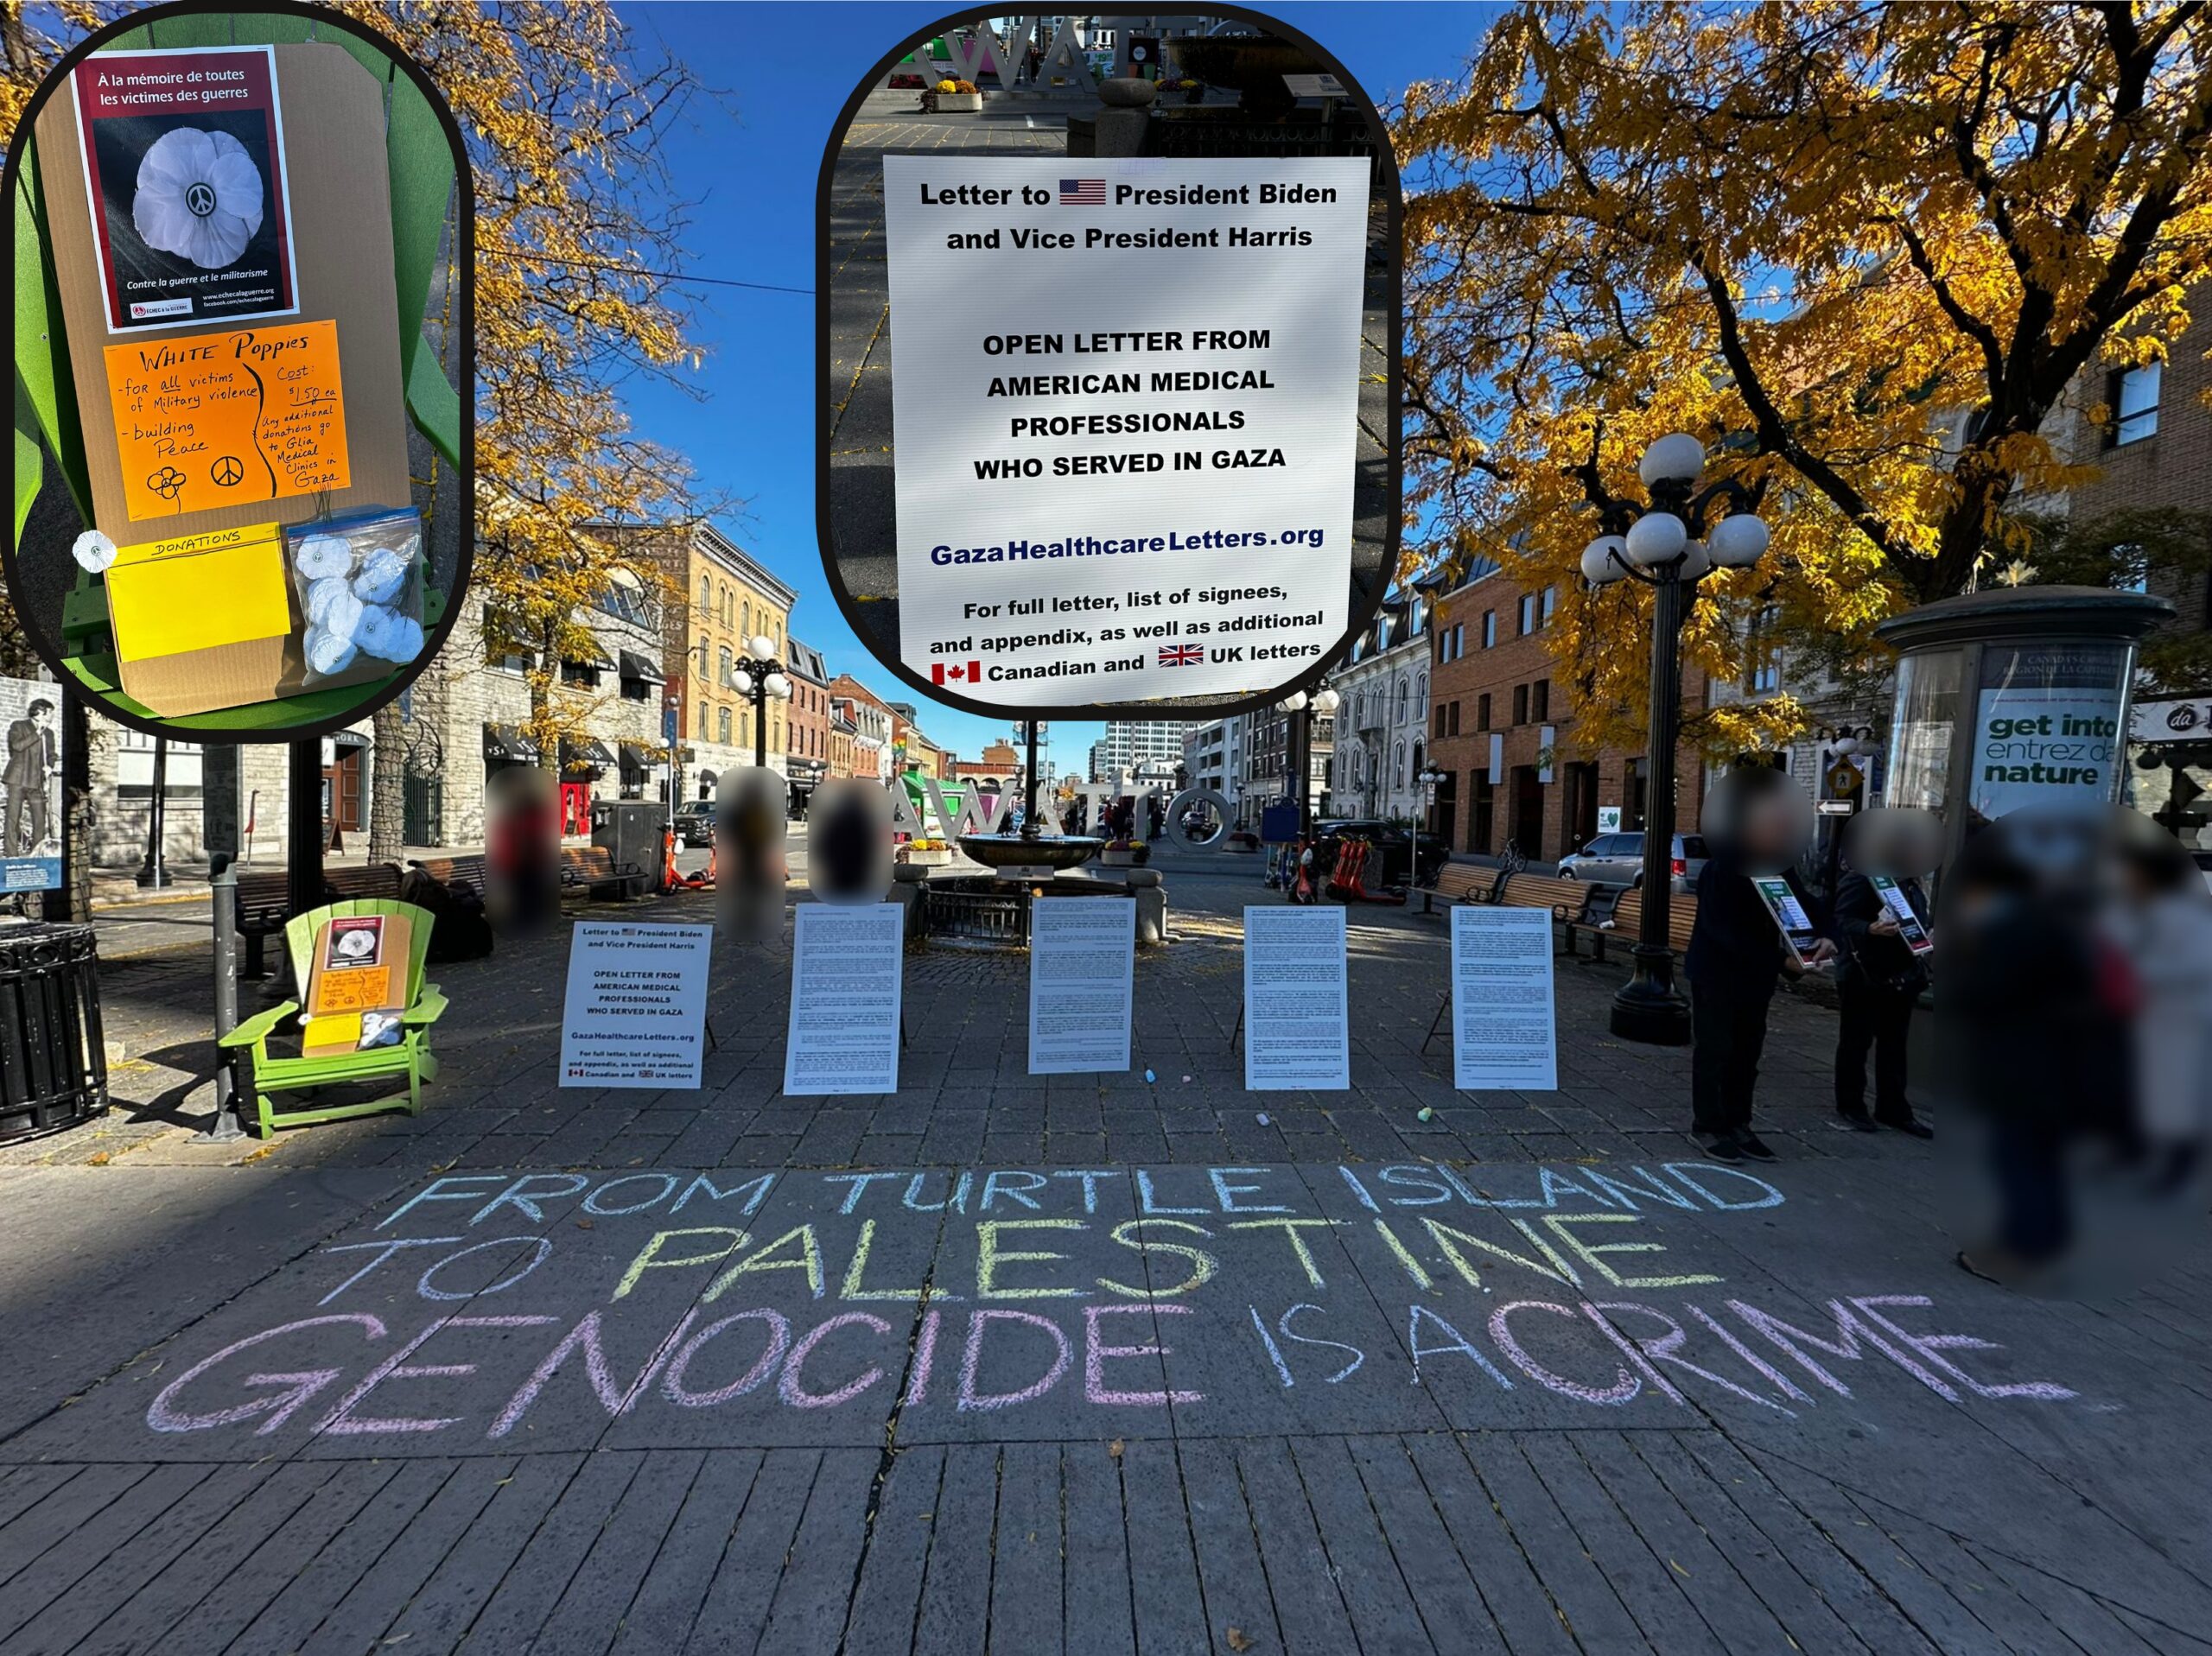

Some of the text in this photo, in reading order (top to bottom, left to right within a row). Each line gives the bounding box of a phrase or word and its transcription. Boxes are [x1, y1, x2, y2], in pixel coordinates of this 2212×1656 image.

[98, 68, 245, 87] À la mémoire de toutes
[99, 86, 248, 105] les victimes des guerres
[920, 182, 1338, 205] Letter to President Biden
[946, 225, 1312, 250] and Vice President Harris
[127, 268, 268, 290] Contre la guerre et le militarisme
[203, 288, 275, 300] www.echecalaguerre.org
[204, 295, 274, 307] facebook.com/echecalaguerre
[140, 333, 308, 372] WHITE Poppies
[983, 329, 1270, 356] OPEN LETTER FROM
[161, 375, 181, 392] all
[189, 371, 233, 384] victims
[277, 365, 315, 381] Cost:
[987, 369, 1274, 397] AMERICAN MEDICAL
[130, 384, 257, 413] of Military violence
[283, 406, 334, 426] additional
[1011, 410, 1245, 437] PROFESSIONALS
[263, 422, 331, 440] donations go
[155, 438, 208, 458] Peace
[269, 441, 279, 452] to
[276, 447, 319, 464] Medical
[286, 460, 318, 474] Clinics
[974, 448, 1286, 480] WHO SERVED IN GAZA
[294, 471, 340, 489] Gaza
[963, 584, 1287, 620] For full letter, list of signees,
[930, 611, 1324, 654] and appendix, as well as additional
[988, 641, 1321, 682] Canadian and UK letters
[1988, 714, 2116, 739] get into
[1986, 739, 2086, 760] entrez
[1985, 763, 2098, 784] nature
[374, 1161, 1787, 1231] FROM TURTLE ISLAND
[316, 1212, 1726, 1306] TO PALESTINE
[146, 1294, 2082, 1439] GENOCIDE IS A CRIME
